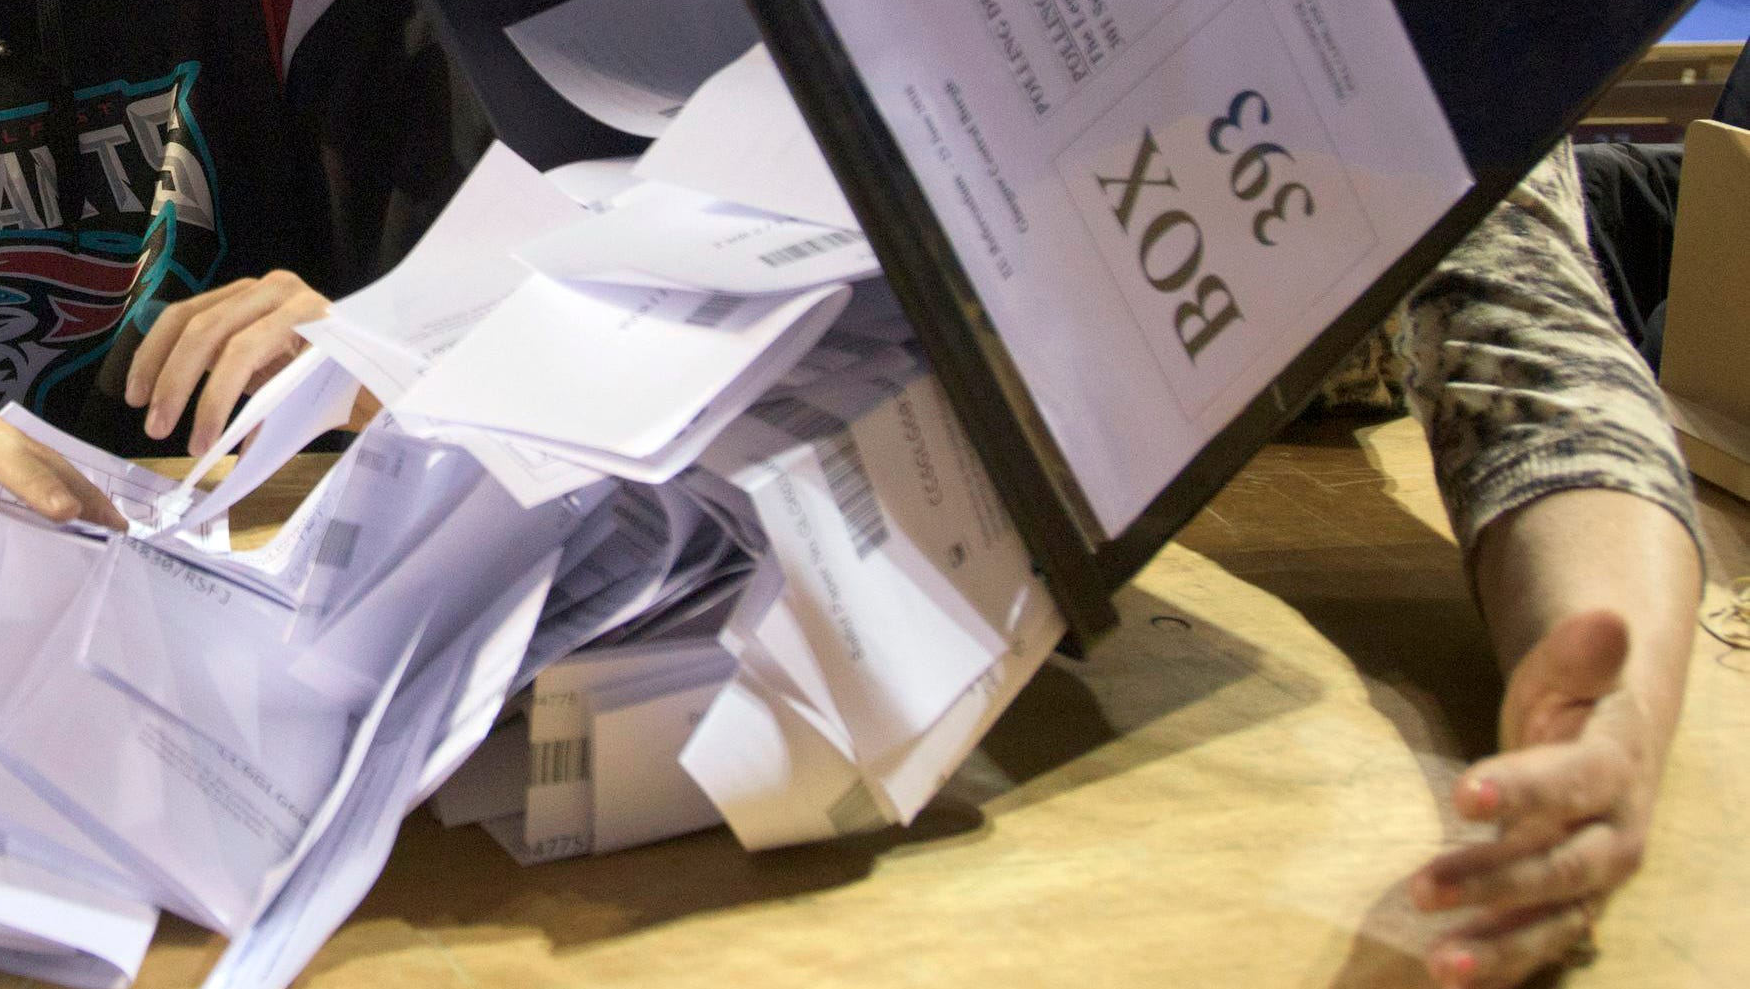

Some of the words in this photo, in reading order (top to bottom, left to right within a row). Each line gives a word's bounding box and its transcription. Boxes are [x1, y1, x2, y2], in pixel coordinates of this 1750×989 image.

[993, 17, 1051, 116] POLLING
[1079, 27, 1105, 66] The
[966, 123, 1000, 178] Central
[1208, 88, 1316, 248] 393
[1096, 131, 1245, 368] BOX
